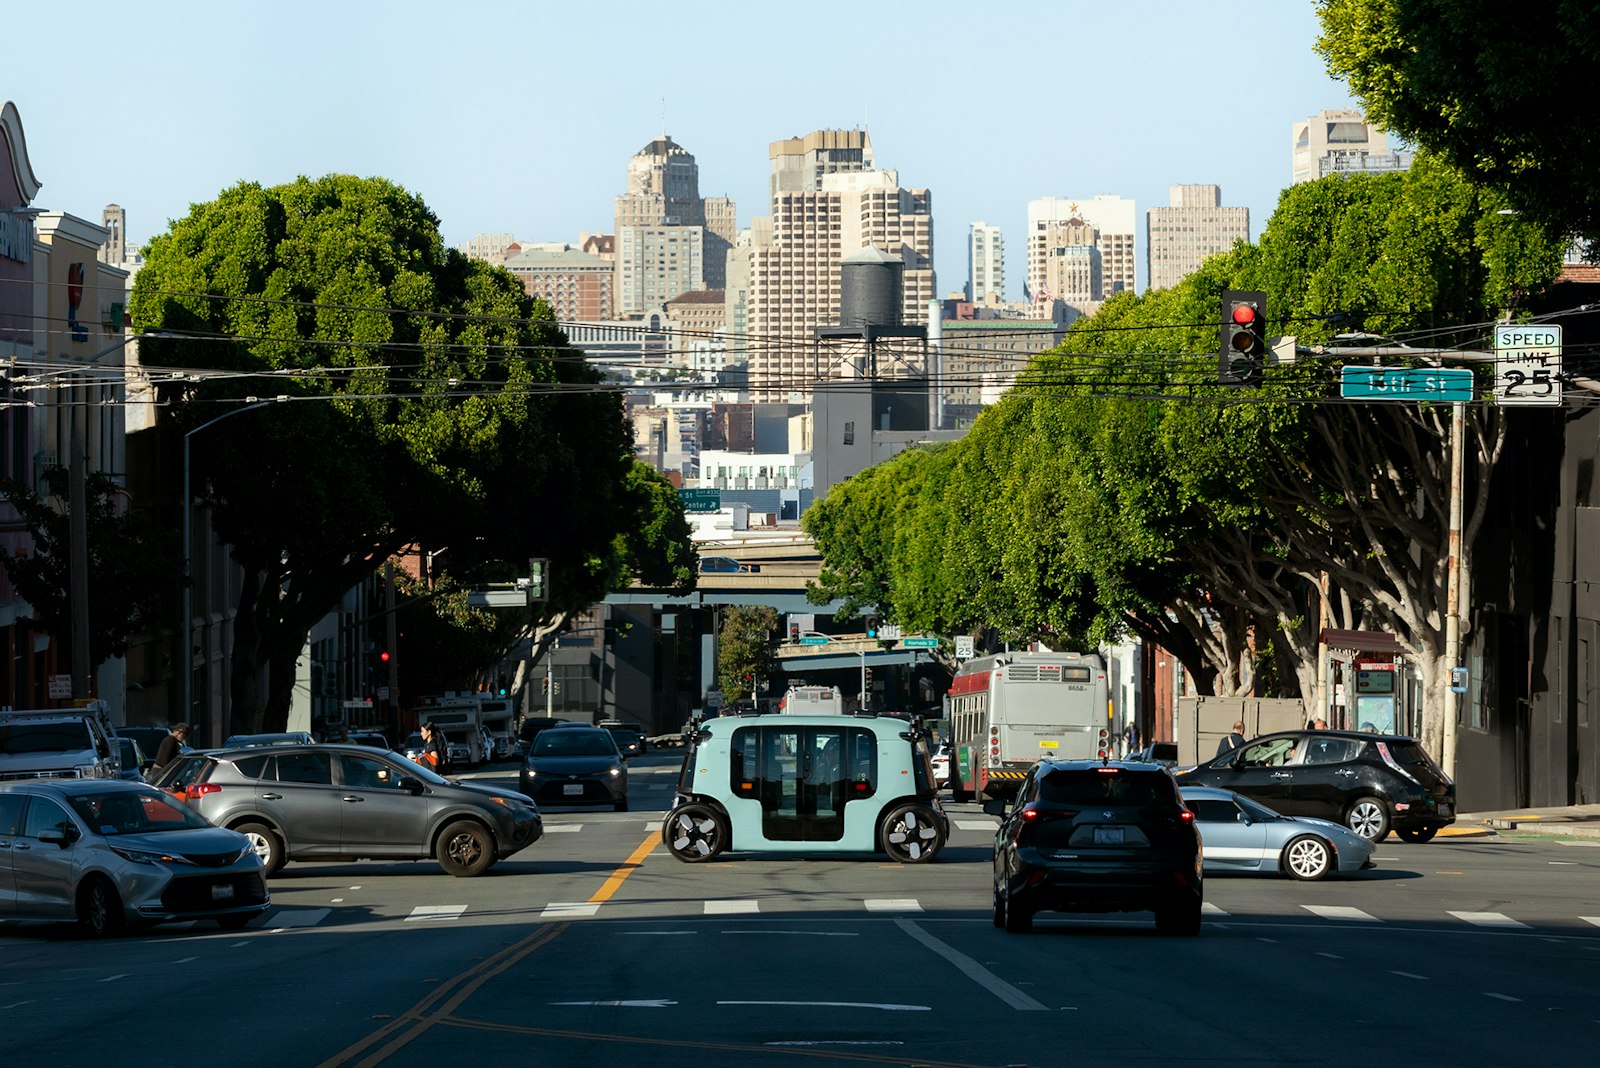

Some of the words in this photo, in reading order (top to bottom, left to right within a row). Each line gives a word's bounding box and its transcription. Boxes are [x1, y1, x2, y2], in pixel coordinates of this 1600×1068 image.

[1502, 333, 1555, 346] SPEED
[1506, 352, 1550, 364] LIMIT
[1425, 376, 1446, 393] St
[1503, 369, 1553, 398] 25
[958, 647, 972, 656] 25
